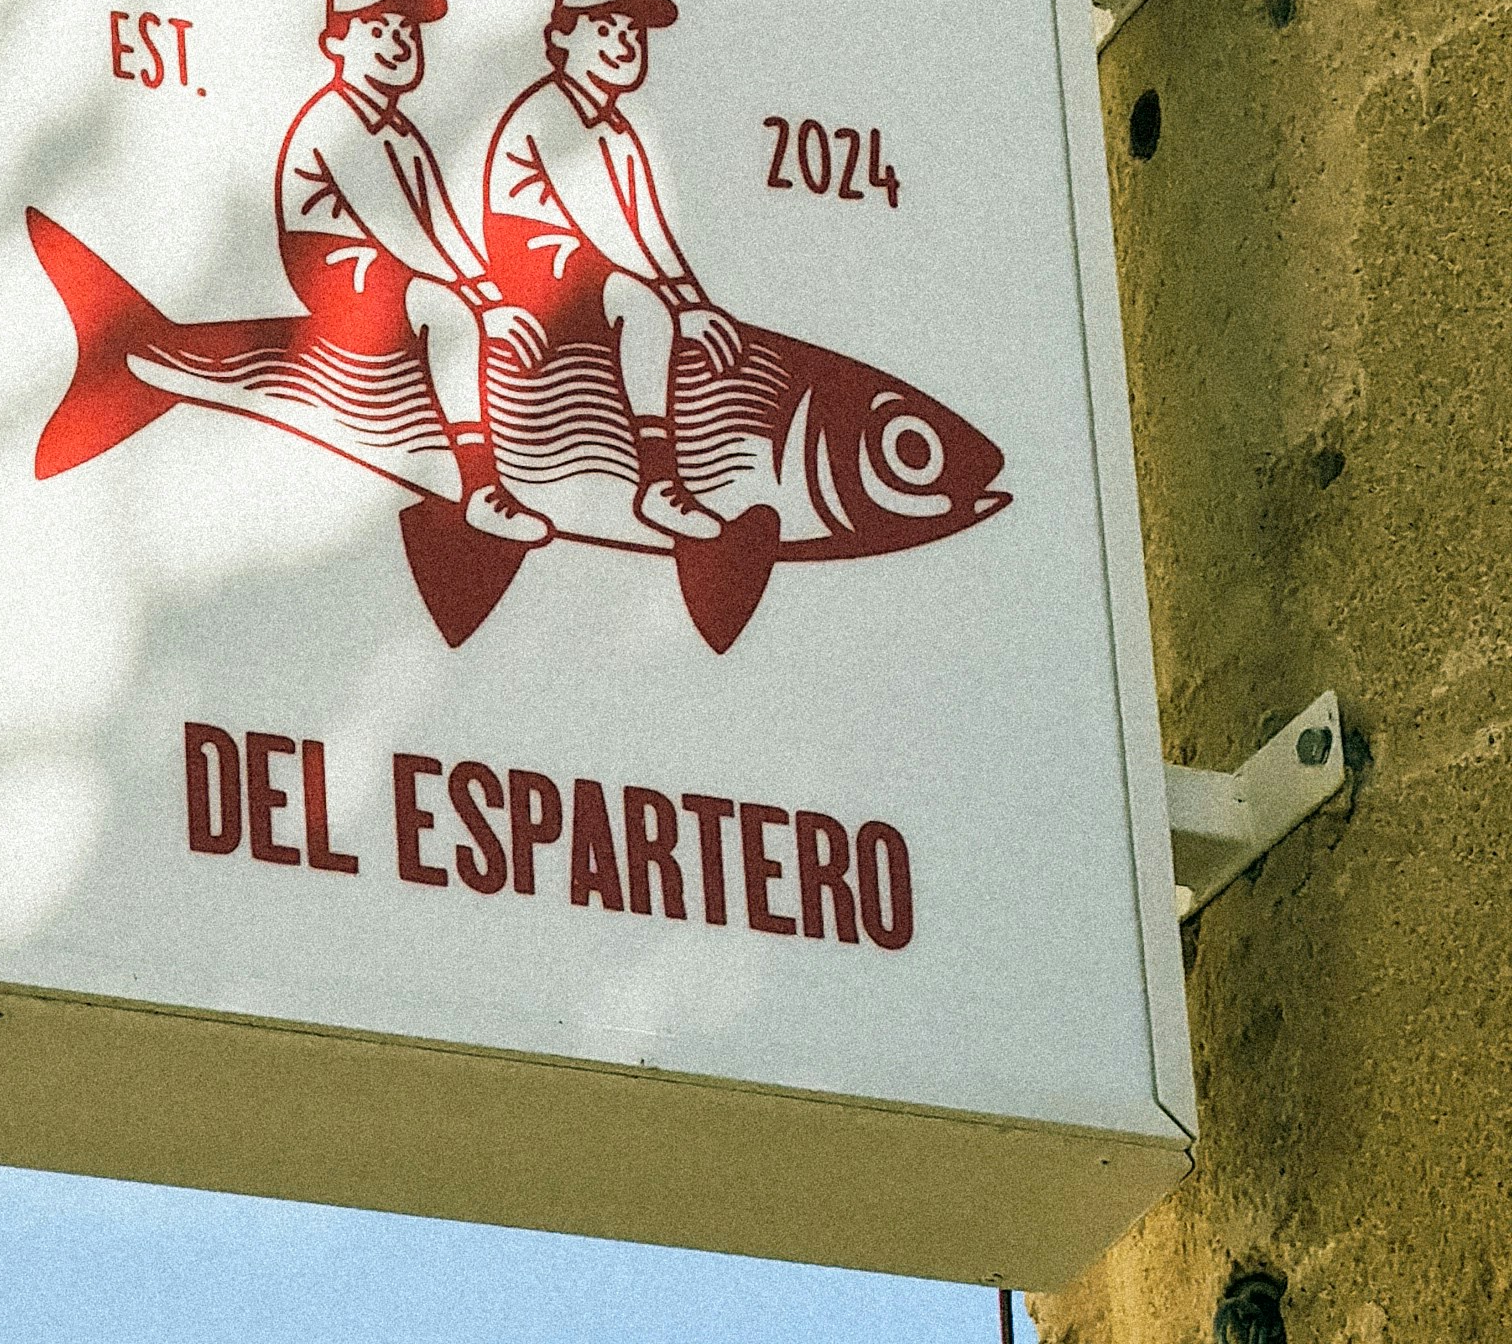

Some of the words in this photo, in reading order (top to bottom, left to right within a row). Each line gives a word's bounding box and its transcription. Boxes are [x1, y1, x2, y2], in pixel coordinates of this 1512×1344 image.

[109, 10, 207, 98] EST.
[764, 116, 899, 207] 2024
[184, 722, 359, 874] DEL
[393, 752, 913, 949] ESPARTERO
